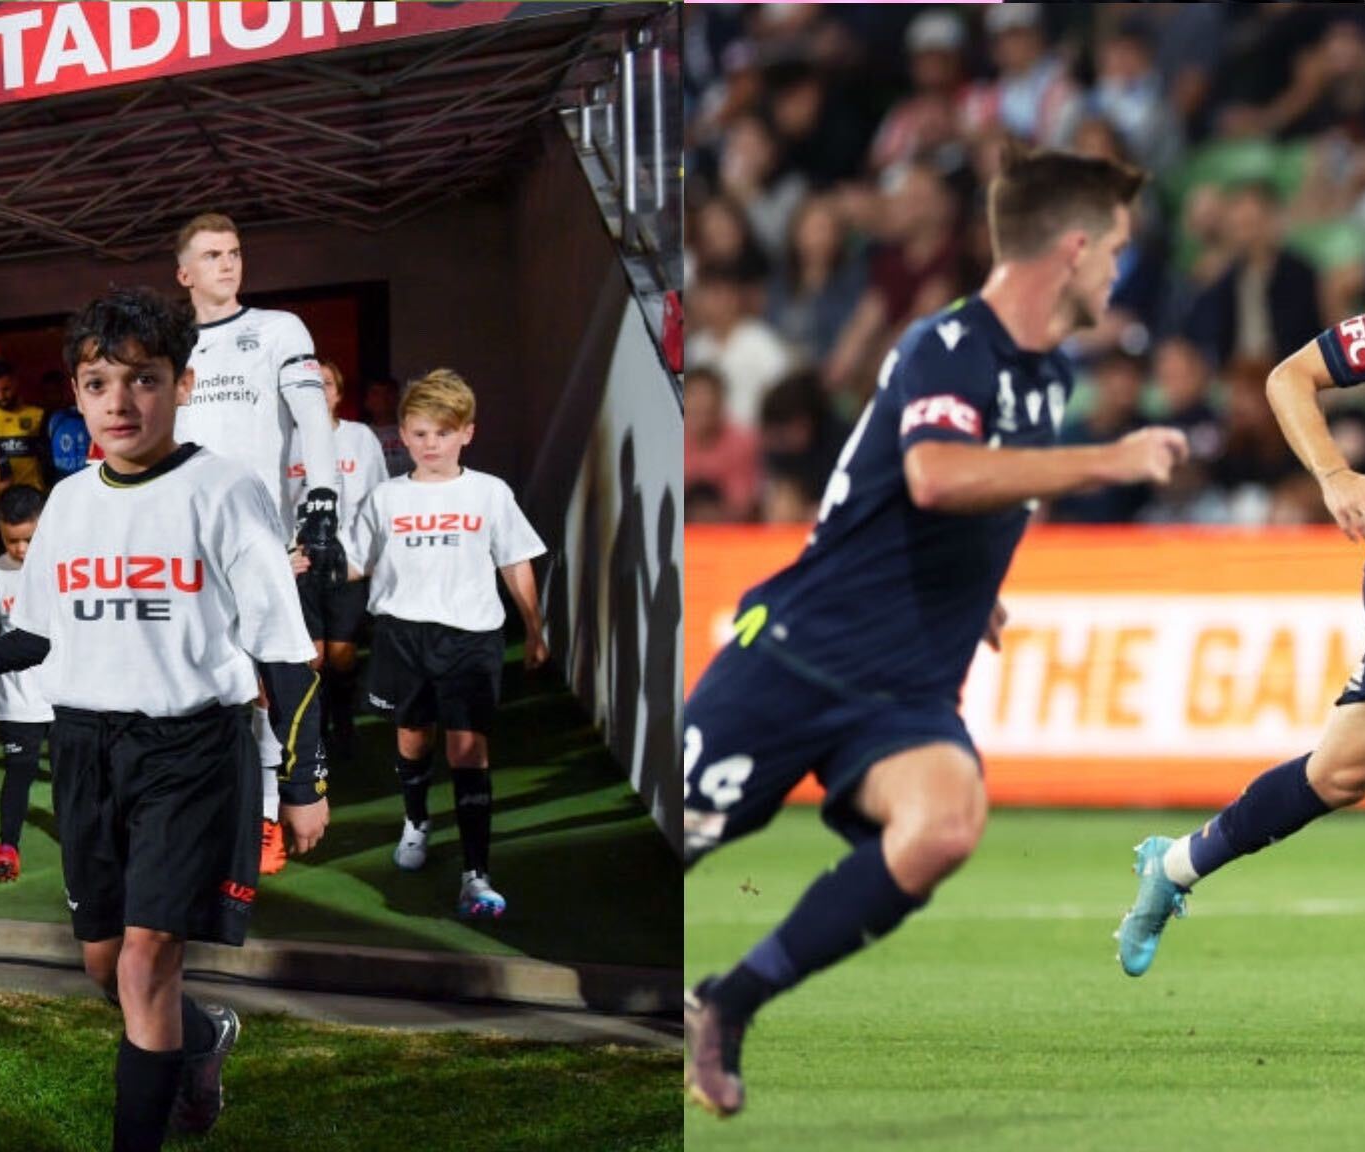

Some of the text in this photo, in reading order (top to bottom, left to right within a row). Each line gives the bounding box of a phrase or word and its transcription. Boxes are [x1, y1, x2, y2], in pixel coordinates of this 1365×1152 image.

[404, 534, 460, 547] UTE
[56, 555, 204, 594] ISUZU
[73, 599, 171, 622] UTE
[995, 625, 1155, 728] THE
